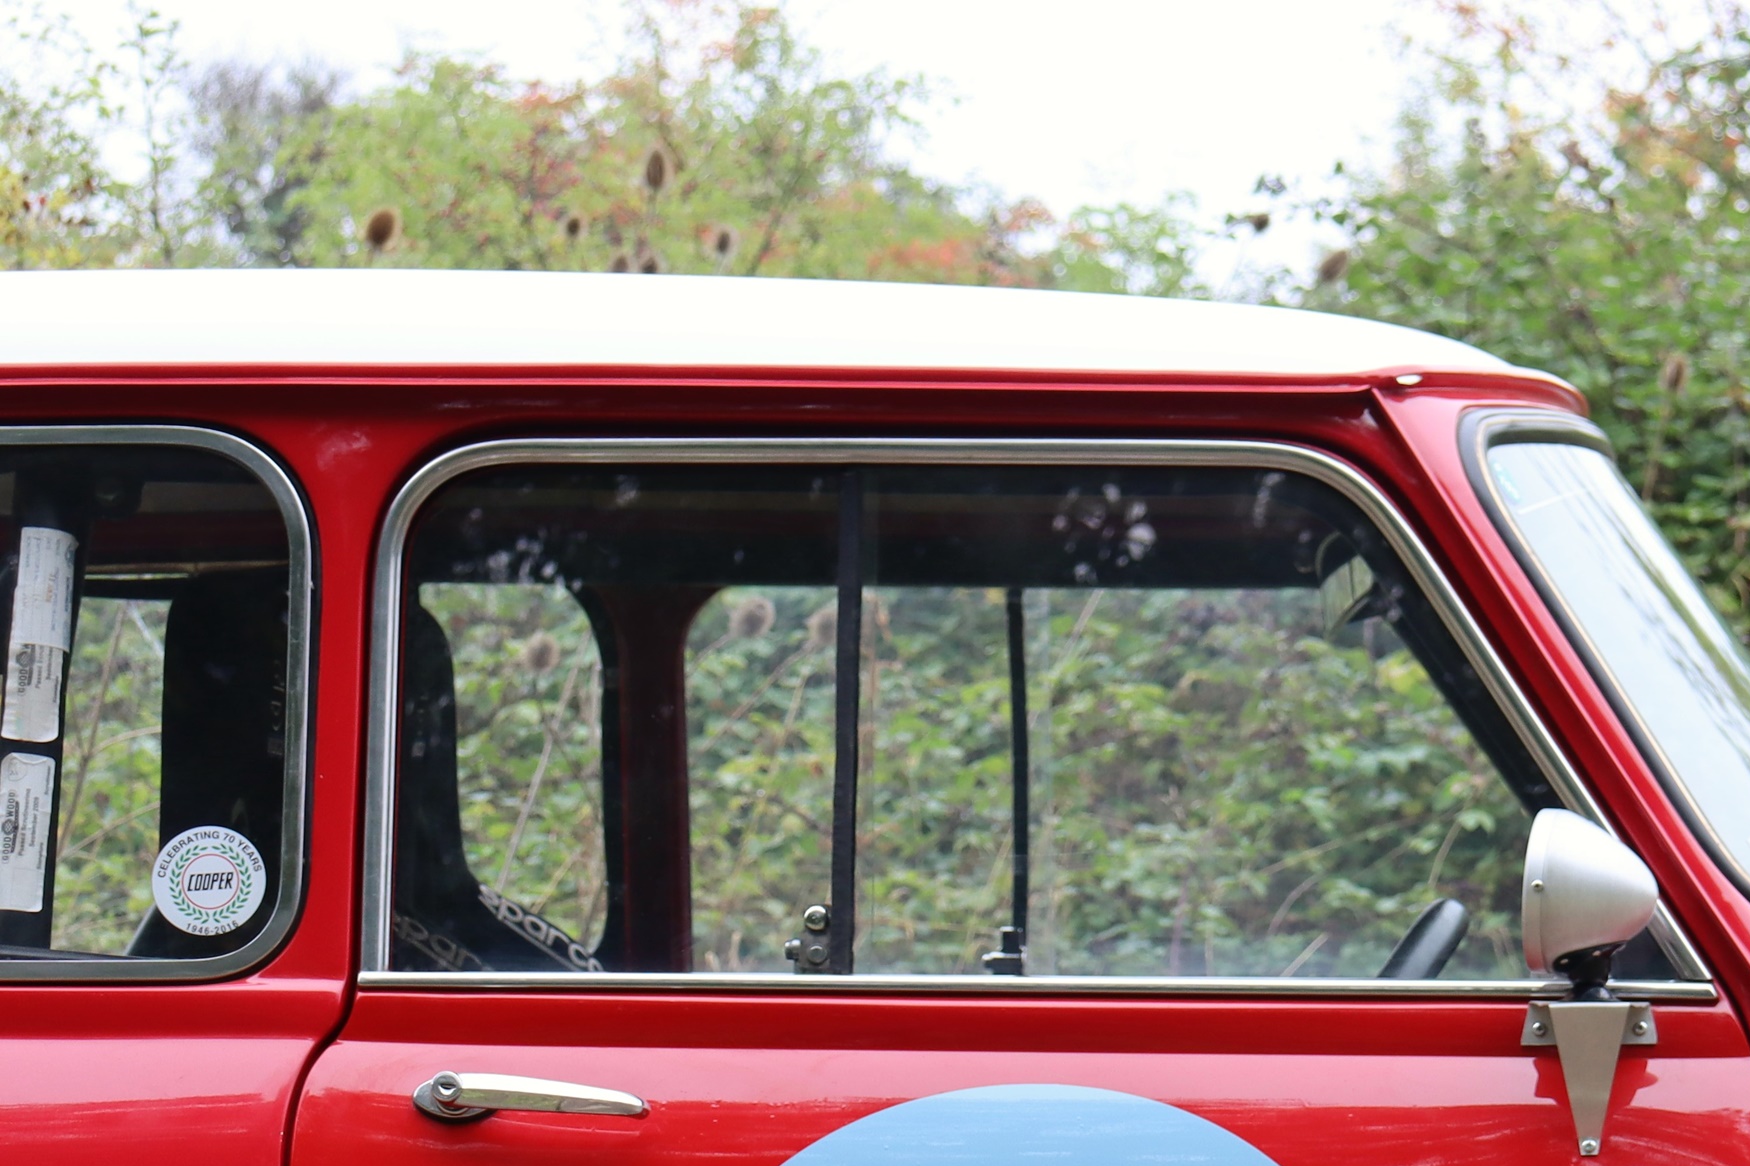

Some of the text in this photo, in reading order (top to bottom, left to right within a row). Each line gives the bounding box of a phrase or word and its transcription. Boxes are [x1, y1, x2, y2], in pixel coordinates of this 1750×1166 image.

[2, 836, 12, 861] GOOD
[7, 791, 16, 818] WOOD
[157, 830, 263, 878] CELEBRATING 70 YEARS
[187, 871, 235, 892] COOPER
[185, 920, 239, 936] 1946-2016
